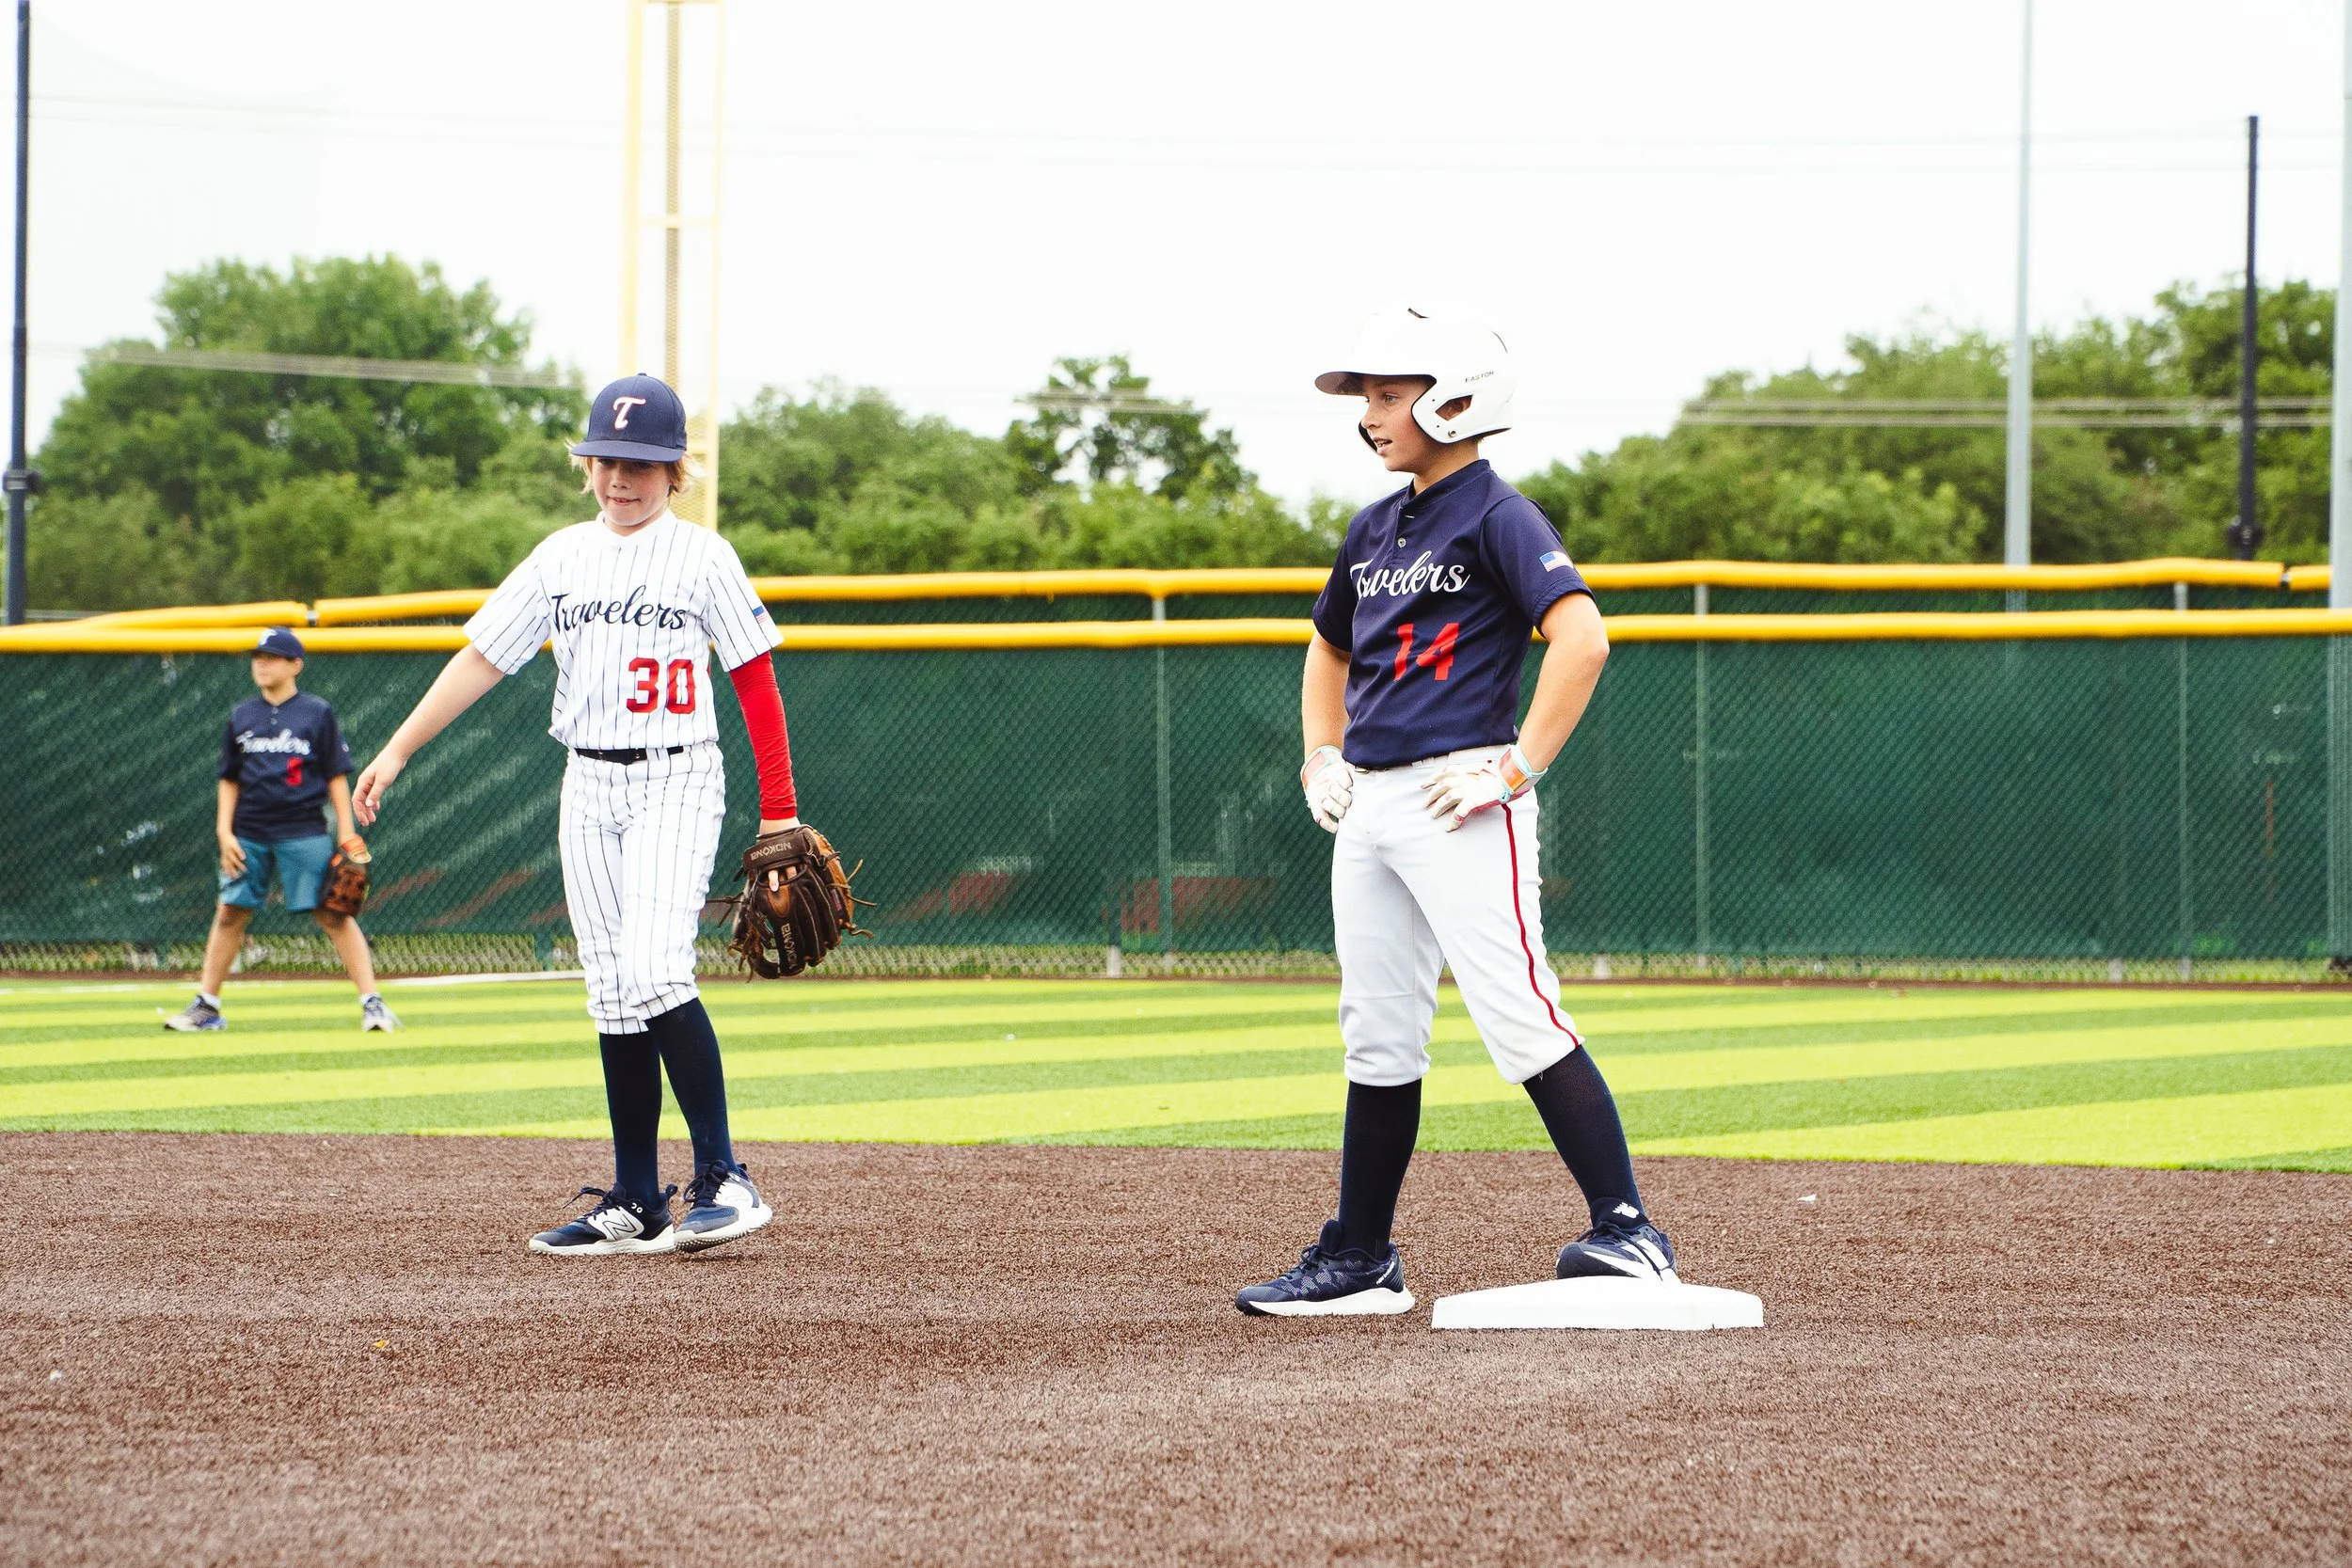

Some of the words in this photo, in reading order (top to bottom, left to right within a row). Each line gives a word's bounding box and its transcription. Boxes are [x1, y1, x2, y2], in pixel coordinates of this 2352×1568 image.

[1465, 371, 1494, 383] EASTON
[612, 396, 646, 430] T
[1350, 550, 1470, 599] Trvelers
[551, 584, 686, 635] Travelers
[1393, 623, 1460, 681] 14
[626, 657, 696, 715] 30
